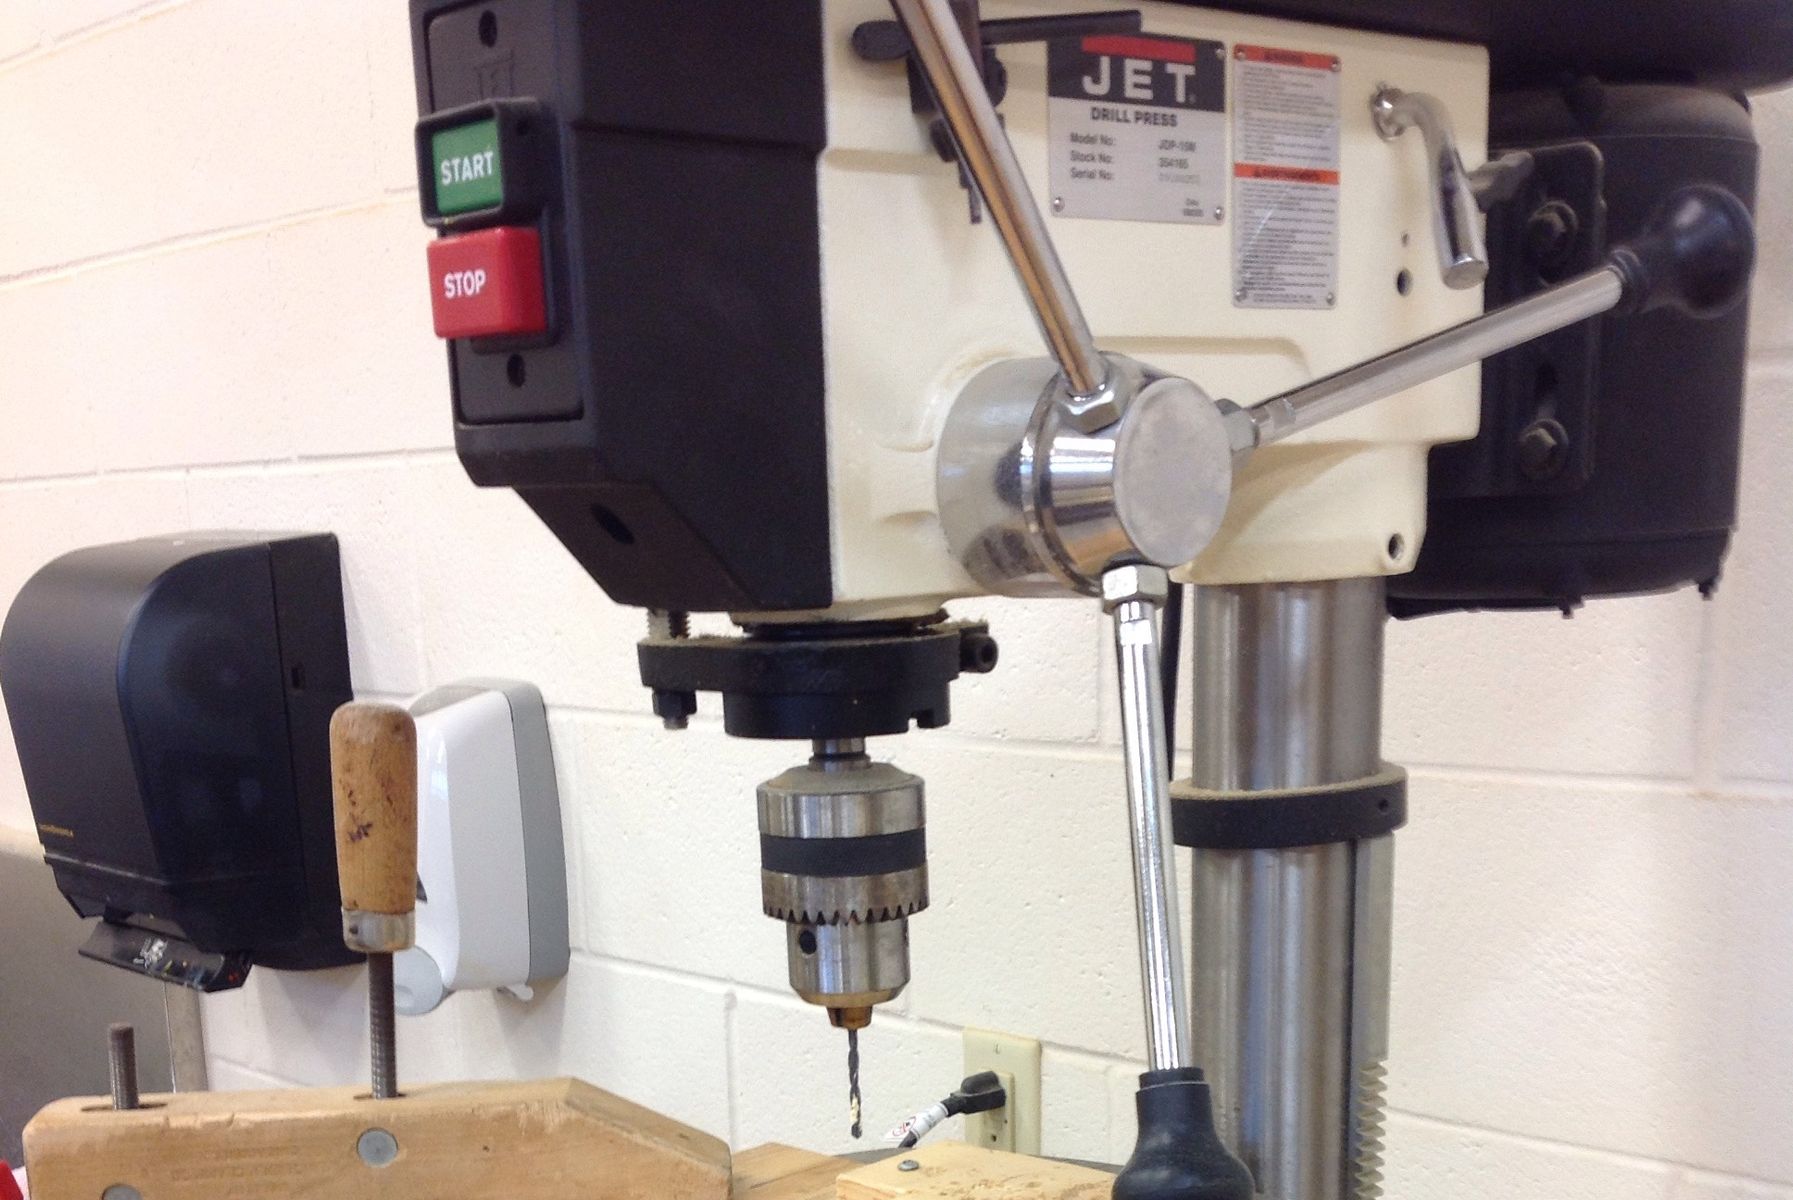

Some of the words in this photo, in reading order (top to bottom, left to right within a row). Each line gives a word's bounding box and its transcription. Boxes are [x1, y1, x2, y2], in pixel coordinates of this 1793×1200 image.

[1081, 55, 1196, 103] JET
[1091, 107, 1131, 124] DRILL
[1134, 111, 1178, 127] PRESS
[1070, 132, 1098, 145] Model
[1070, 150, 1096, 163] Stock
[441, 150, 494, 185] START
[1070, 167, 1097, 180] Serial
[444, 269, 486, 299] STOP
